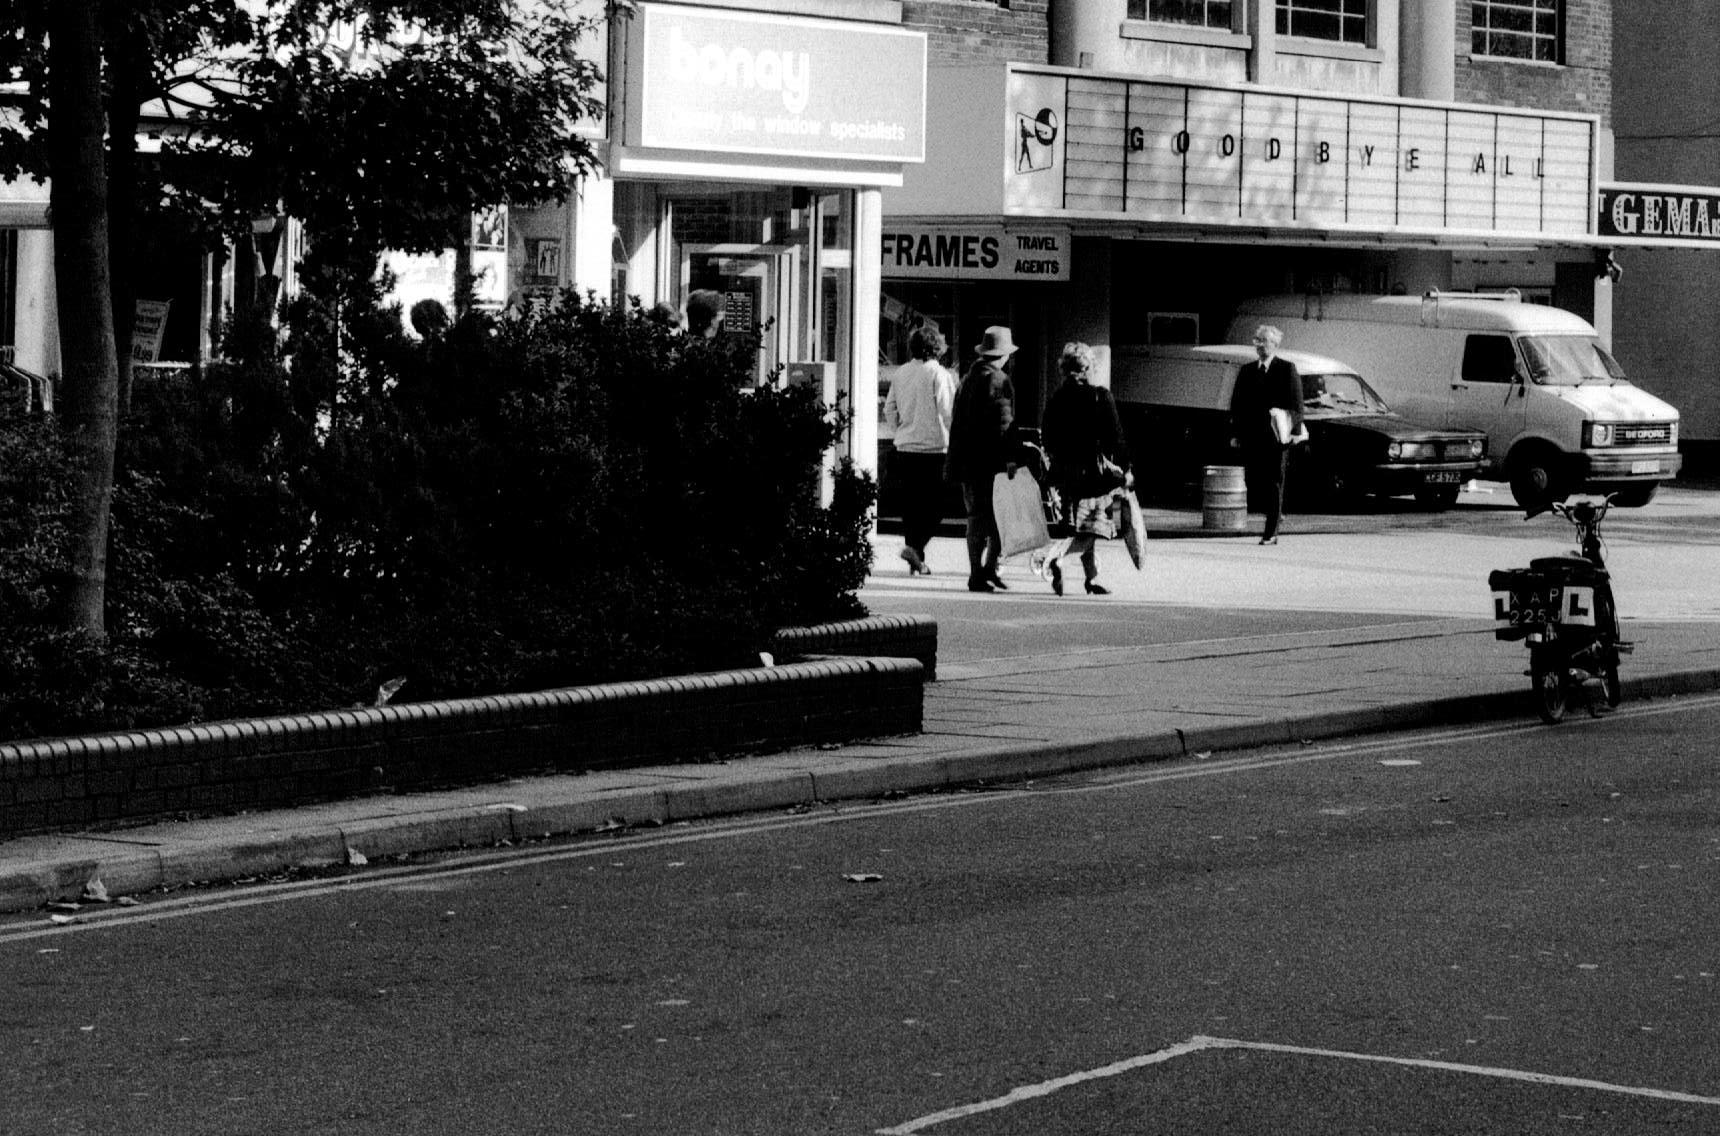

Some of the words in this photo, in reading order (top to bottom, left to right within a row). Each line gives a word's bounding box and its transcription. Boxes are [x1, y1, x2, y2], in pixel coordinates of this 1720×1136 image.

[764, 114, 822, 135] window
[830, 119, 906, 142] specialists
[1129, 127, 1420, 170] GOODBYE
[1473, 152, 1545, 178] ALL
[1612, 193, 1712, 237] GEMA
[881, 234, 999, 269] FRAMES
[1016, 235, 1059, 251] TRAVEL
[1014, 259, 1060, 275] AGENTS
[1510, 609, 1561, 625] 225J
[1569, 593, 1589, 617] L
